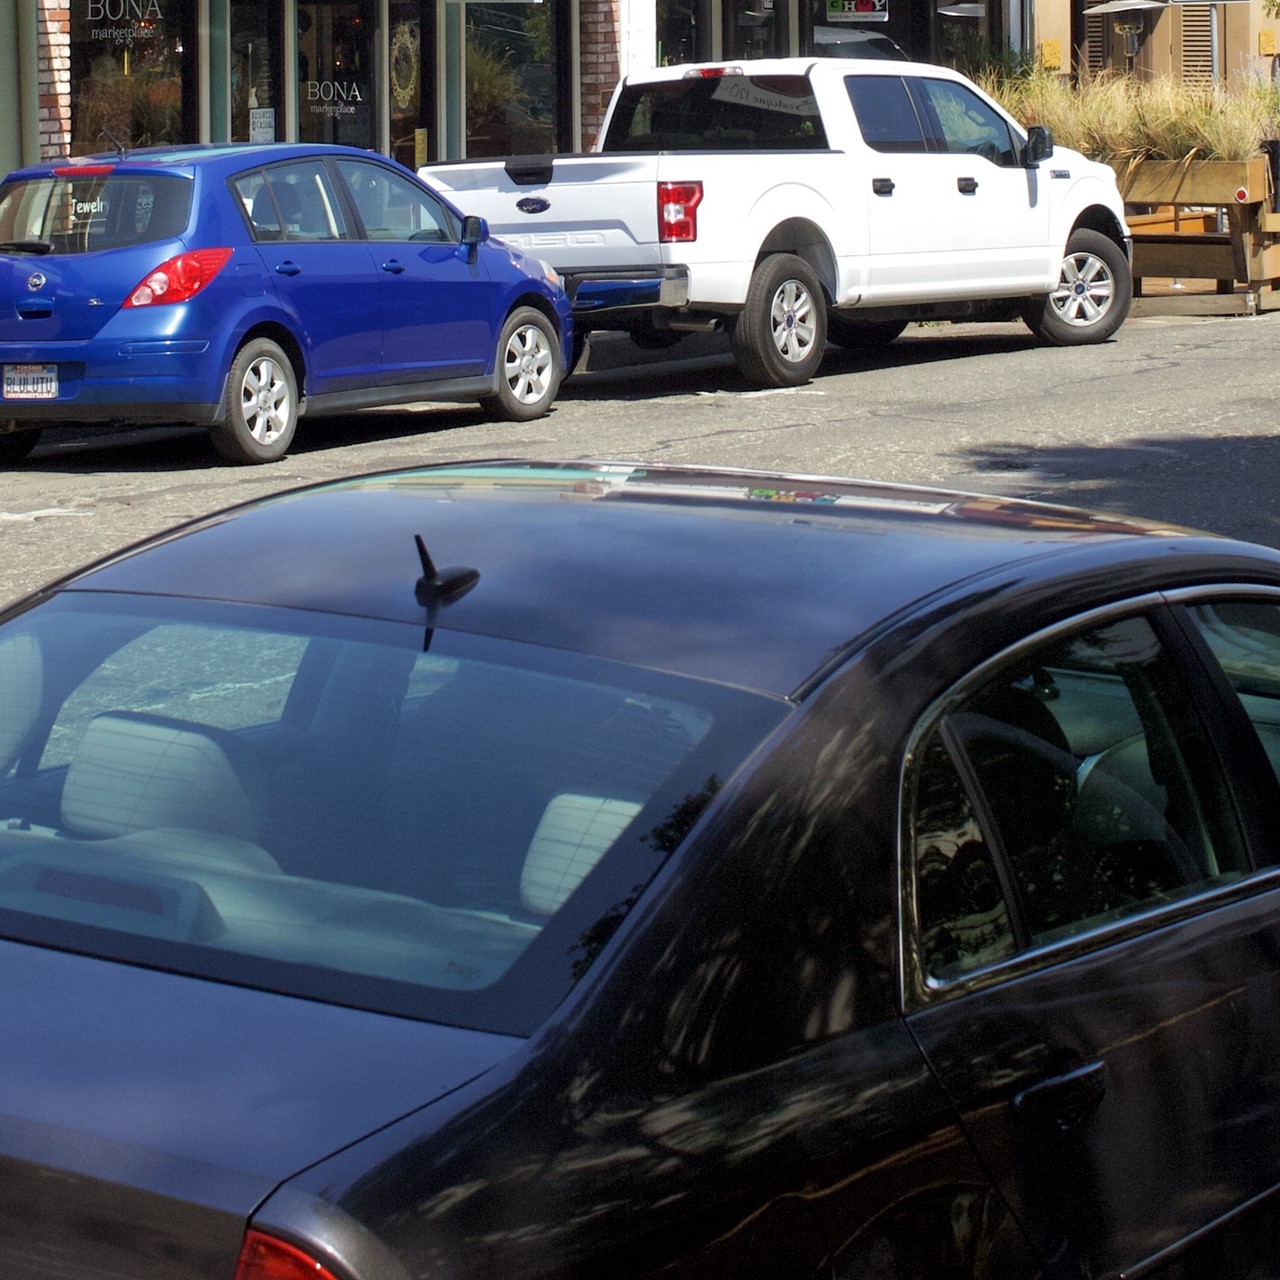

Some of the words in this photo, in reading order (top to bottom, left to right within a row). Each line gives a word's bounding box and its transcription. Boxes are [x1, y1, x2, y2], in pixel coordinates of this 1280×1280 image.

[91, 20, 155, 48] marketplace
[306, 81, 363, 102] BONA
[310, 100, 356, 120] marketplace
